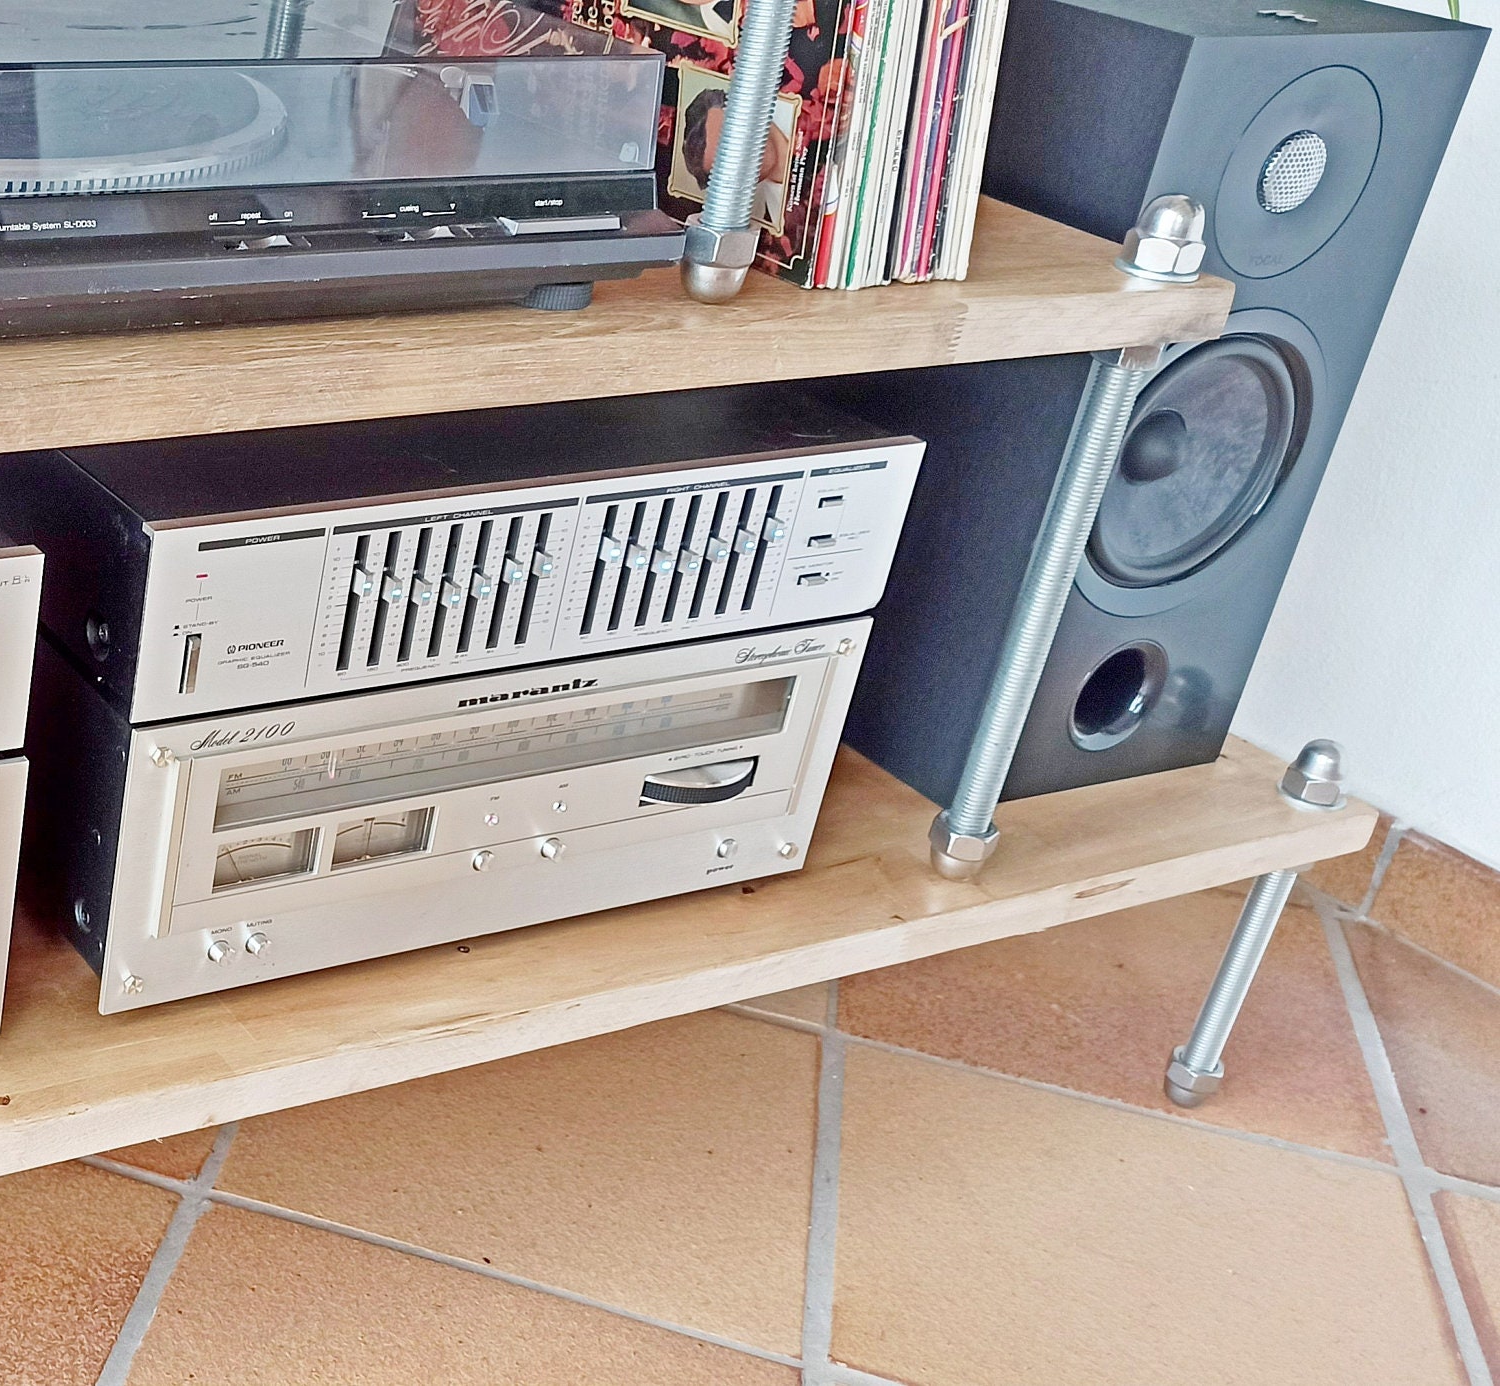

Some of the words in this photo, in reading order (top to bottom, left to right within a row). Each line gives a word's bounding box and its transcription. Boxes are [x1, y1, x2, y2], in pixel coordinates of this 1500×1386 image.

[241, 211, 262, 222] repeat
[32, 221, 63, 233] System
[666, 485, 691, 494] RIGHT
[693, 481, 731, 491] CHANNEL
[424, 514, 449, 523] LEFT
[453, 509, 494, 519] CHANNEL
[244, 535, 281, 545] POWER
[185, 595, 213, 603] POWER
[237, 639, 285, 652] PIONEER
[458, 677, 598, 709] marantz
[190, 729, 240, 751] Model
[240, 721, 296, 743] 2100
[227, 772, 243, 781] FM
[226, 787, 241, 796] AM
[706, 864, 734, 876] power
[245, 919, 273, 929] MUTING
[210, 926, 233, 936] MONO
